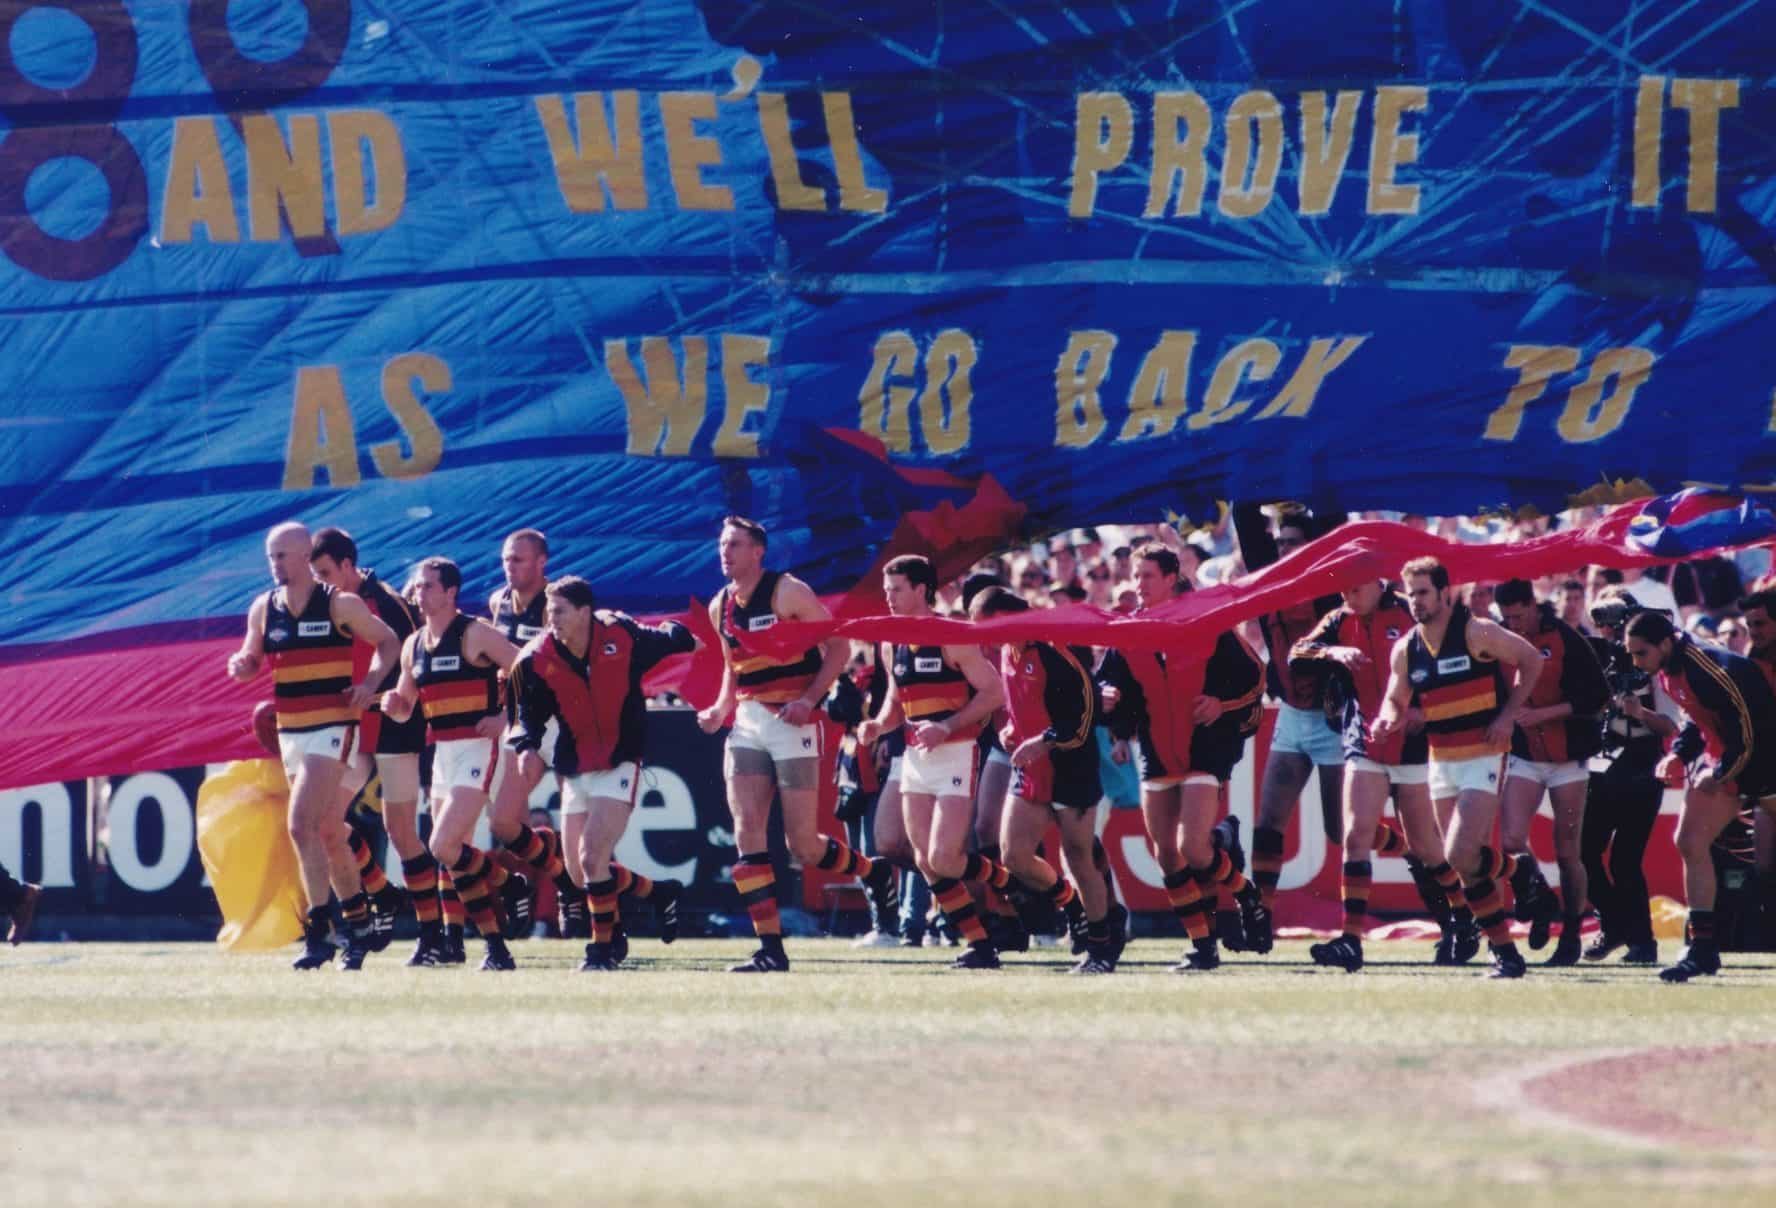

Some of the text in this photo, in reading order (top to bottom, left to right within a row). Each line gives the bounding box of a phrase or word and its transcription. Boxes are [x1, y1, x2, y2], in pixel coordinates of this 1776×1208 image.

[161, 57, 1739, 244] AND WE'LL PROVE IT
[281, 330, 1657, 491] AS WE GO BACK TO
